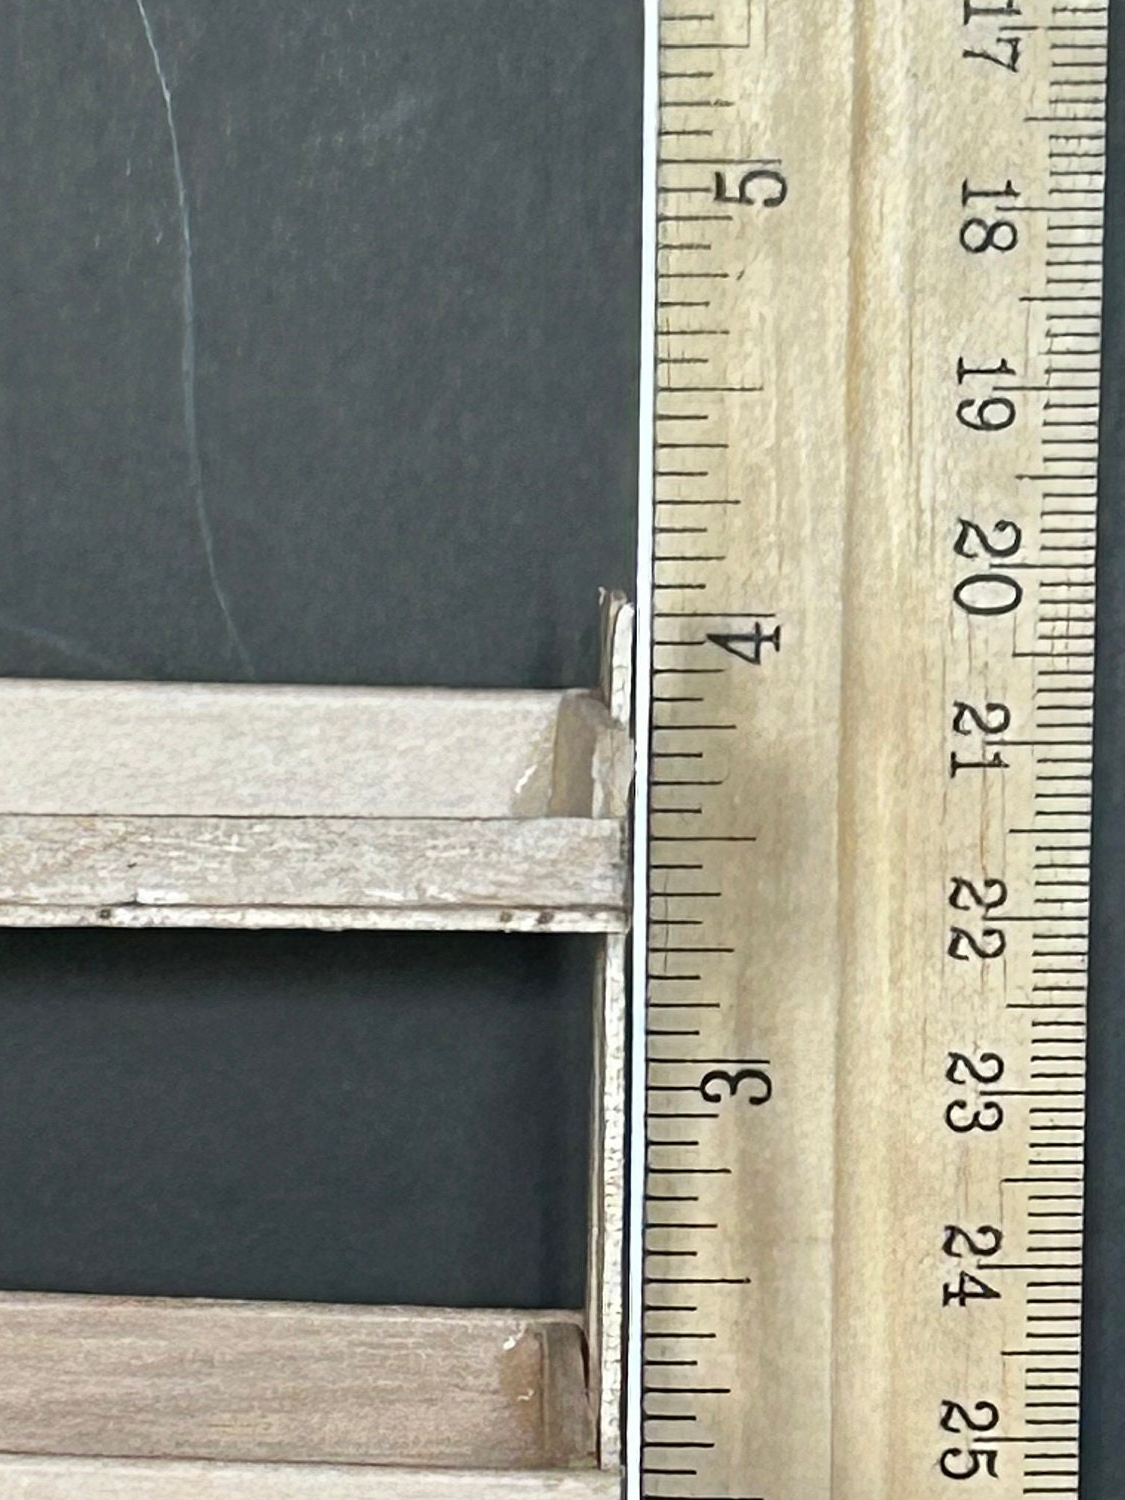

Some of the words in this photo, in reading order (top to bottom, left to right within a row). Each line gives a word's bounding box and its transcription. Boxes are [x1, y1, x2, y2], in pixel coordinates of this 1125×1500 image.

[962, 0, 1022, 73] 17
[714, 169, 787, 207] 5
[959, 178, 1021, 253] 18
[956, 356, 1018, 431] 19
[953, 518, 1023, 616] 20
[706, 621, 781, 665] 4
[949, 701, 1011, 779] 21
[947, 877, 1008, 961] 22
[699, 1067, 773, 1106] 3
[945, 1051, 1004, 1134] 23
[942, 1225, 1003, 1308] 24
[939, 1400, 1000, 1480] 25
